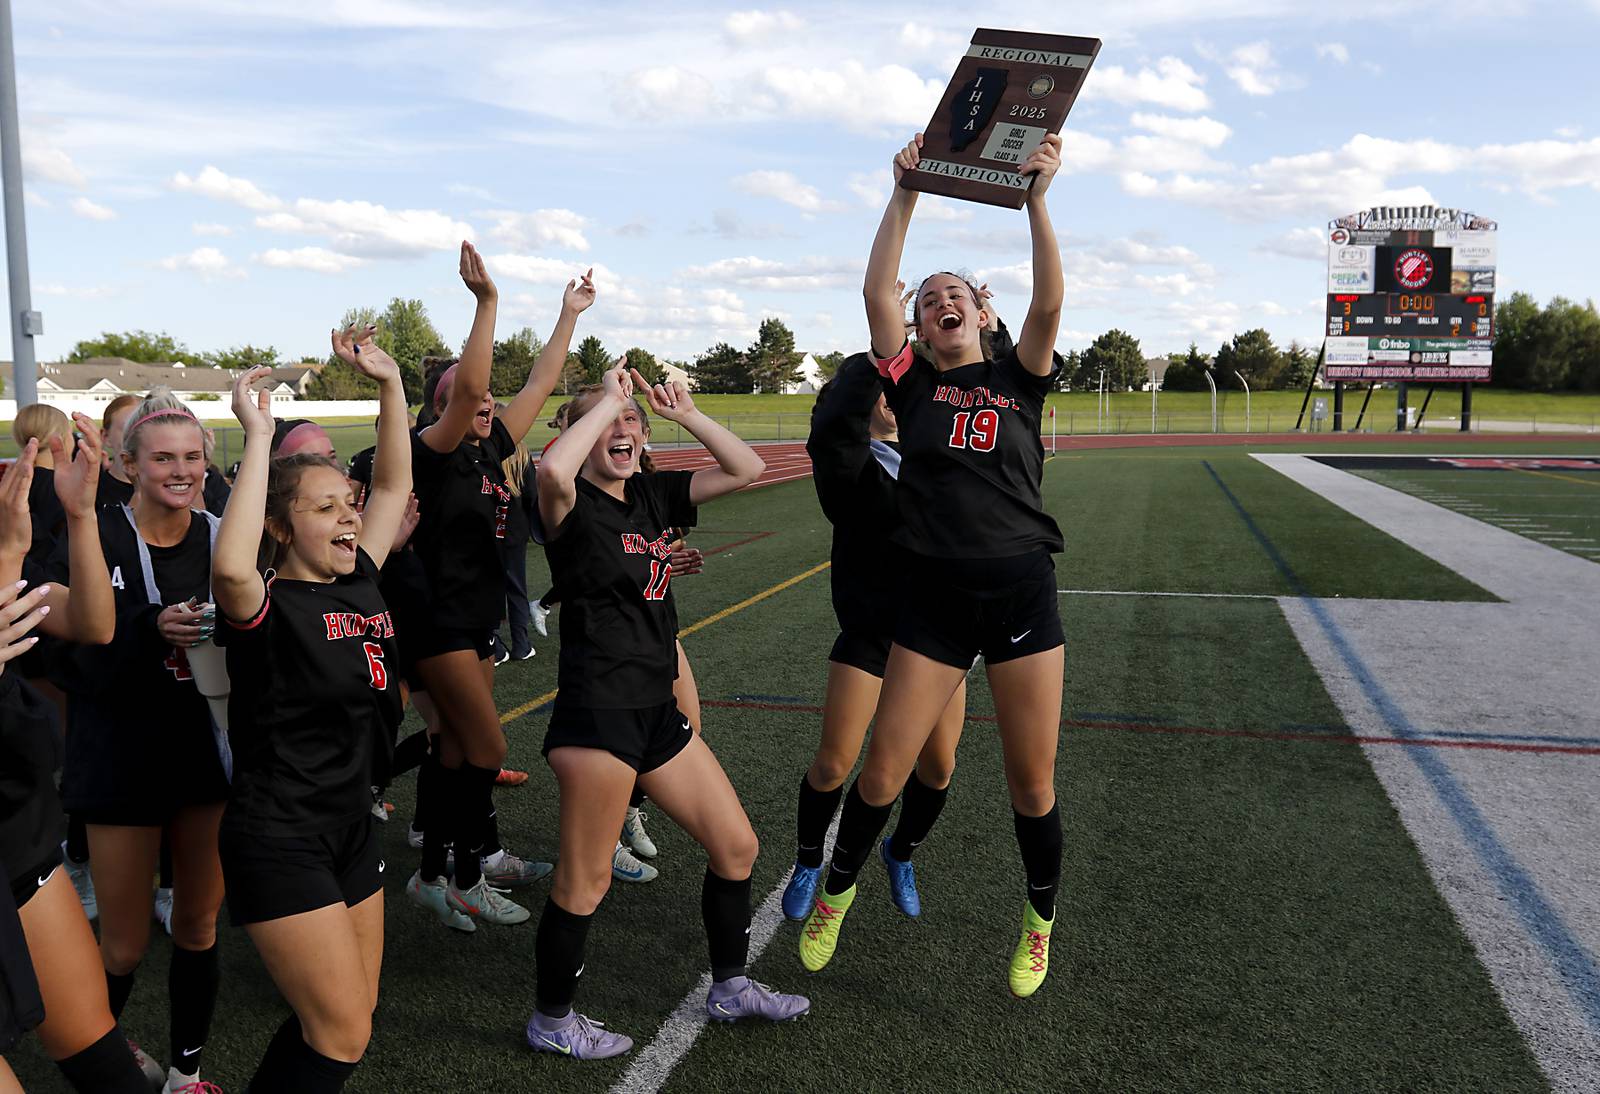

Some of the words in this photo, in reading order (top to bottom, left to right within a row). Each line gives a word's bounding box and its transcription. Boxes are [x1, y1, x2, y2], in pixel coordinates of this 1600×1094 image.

[980, 47, 1073, 67] REGIONAL
[963, 76, 984, 131] IHSA
[1009, 104, 1047, 120] 2025
[1009, 128, 1027, 139] GIRLS
[1001, 138, 1025, 150] SOCCER
[994, 151, 1011, 161] CLASS
[916, 159, 1024, 188] CHAMPIONS
[1370, 204, 1461, 223] Huntley
[1399, 251, 1429, 264] HUNTLEY
[1344, 303, 1352, 315] 3
[1399, 295, 1433, 311] 0:00
[1478, 304, 1487, 316] 0
[1356, 316, 1374, 324] DOWN
[1384, 316, 1393, 324] TO
[1393, 316, 1402, 324] GO
[1418, 317, 1432, 325] BALL
[1431, 317, 1440, 325] ON
[1450, 317, 1462, 325] QTR
[1344, 321, 1350, 332] 3
[1451, 324, 1460, 336] 2
[1390, 339, 1411, 349] fnbo
[1383, 366, 1414, 377] SCHOOL
[1414, 367, 1449, 377] ATHLETIC
[948, 409, 1000, 453] 19
[363, 641, 388, 691] 6
